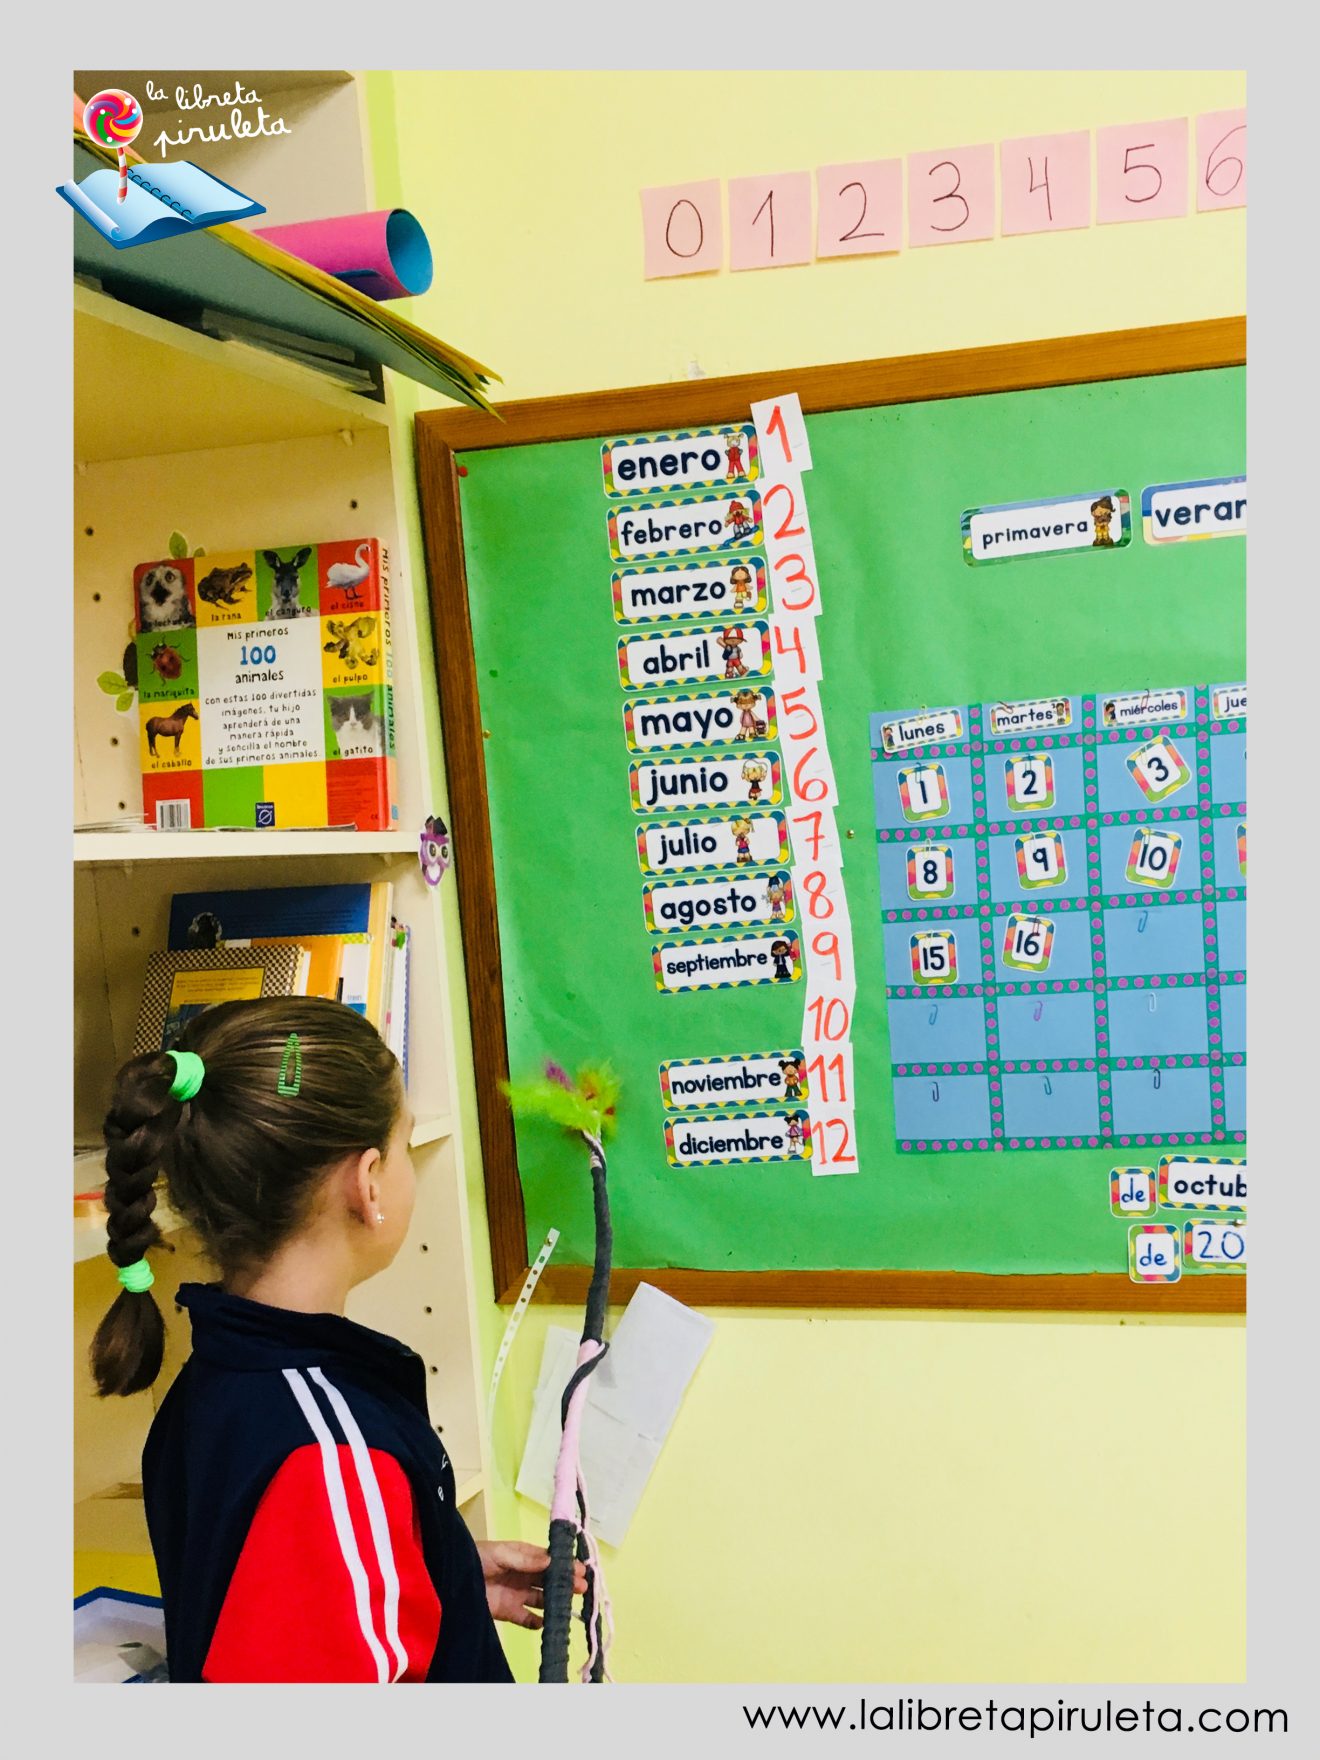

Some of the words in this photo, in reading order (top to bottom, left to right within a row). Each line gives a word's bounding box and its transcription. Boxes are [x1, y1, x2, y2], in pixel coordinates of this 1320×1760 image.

[666, 199, 704, 258] 0
[751, 189, 774, 257] 1
[838, 181, 885, 242] 2
[929, 161, 970, 232] 3
[1027, 155, 1053, 221] 4
[1123, 143, 1163, 203] 5
[1205, 125, 1247, 197] 6
[766, 405, 793, 463] 1
[617, 448, 721, 481] enero
[763, 484, 806, 540] 2
[620, 518, 722, 546] febrero
[982, 520, 1088, 550] primavera
[630, 581, 726, 607] marzo
[774, 553, 815, 611] 3
[245, 627, 289, 641] primeros
[240, 644, 276, 665] 100
[642, 640, 711, 675] abril
[774, 626, 807, 674] 4
[235, 669, 284, 684] animales
[344, 673, 368, 684] pulpo
[205, 697, 220, 705] con
[223, 695, 248, 704] estas
[252, 693, 267, 701] 100
[270, 689, 317, 700] divertidas
[269, 705, 279, 713] tu
[282, 704, 301, 713] hijo
[1120, 699, 1178, 717] miércoles
[1224, 696, 1247, 713] jue
[272, 717, 282, 726] de
[285, 717, 301, 725] una
[640, 706, 734, 739] mayo
[780, 686, 818, 741] 5
[997, 708, 1053, 727] martes
[227, 742, 260, 752] sencilla
[264, 740, 272, 749] el
[275, 739, 308, 748] nombre
[230, 731, 262, 740] manera
[899, 722, 945, 742] lunes
[205, 757, 216, 765] de
[219, 755, 233, 764] sus
[236, 752, 276, 765] primeros
[344, 745, 373, 757] gatito
[793, 746, 829, 801] 6
[1023, 769, 1038, 796] 2
[1146, 756, 1170, 783] 3
[646, 766, 729, 806] junio
[918, 780, 928, 805] 1
[657, 827, 717, 865] julio
[793, 810, 826, 861] 7
[1032, 847, 1050, 872] 9
[1139, 843, 1168, 871] 10
[923, 859, 938, 885] 8
[660, 888, 757, 925] agosto
[803, 870, 834, 919] 8
[811, 931, 842, 981] 9
[1015, 930, 1040, 956] 16
[666, 948, 768, 977] septiembre
[922, 945, 945, 970] 15
[807, 995, 849, 1042] 10
[671, 1066, 781, 1095] noviembre
[808, 1053, 847, 1103] 11
[678, 1128, 784, 1155] diciembre
[811, 1118, 855, 1165] 12
[1121, 1177, 1146, 1203] de
[1174, 1174, 1247, 1198] octub
[1139, 1243, 1167, 1267] de
[1198, 1231, 1246, 1260] 20
